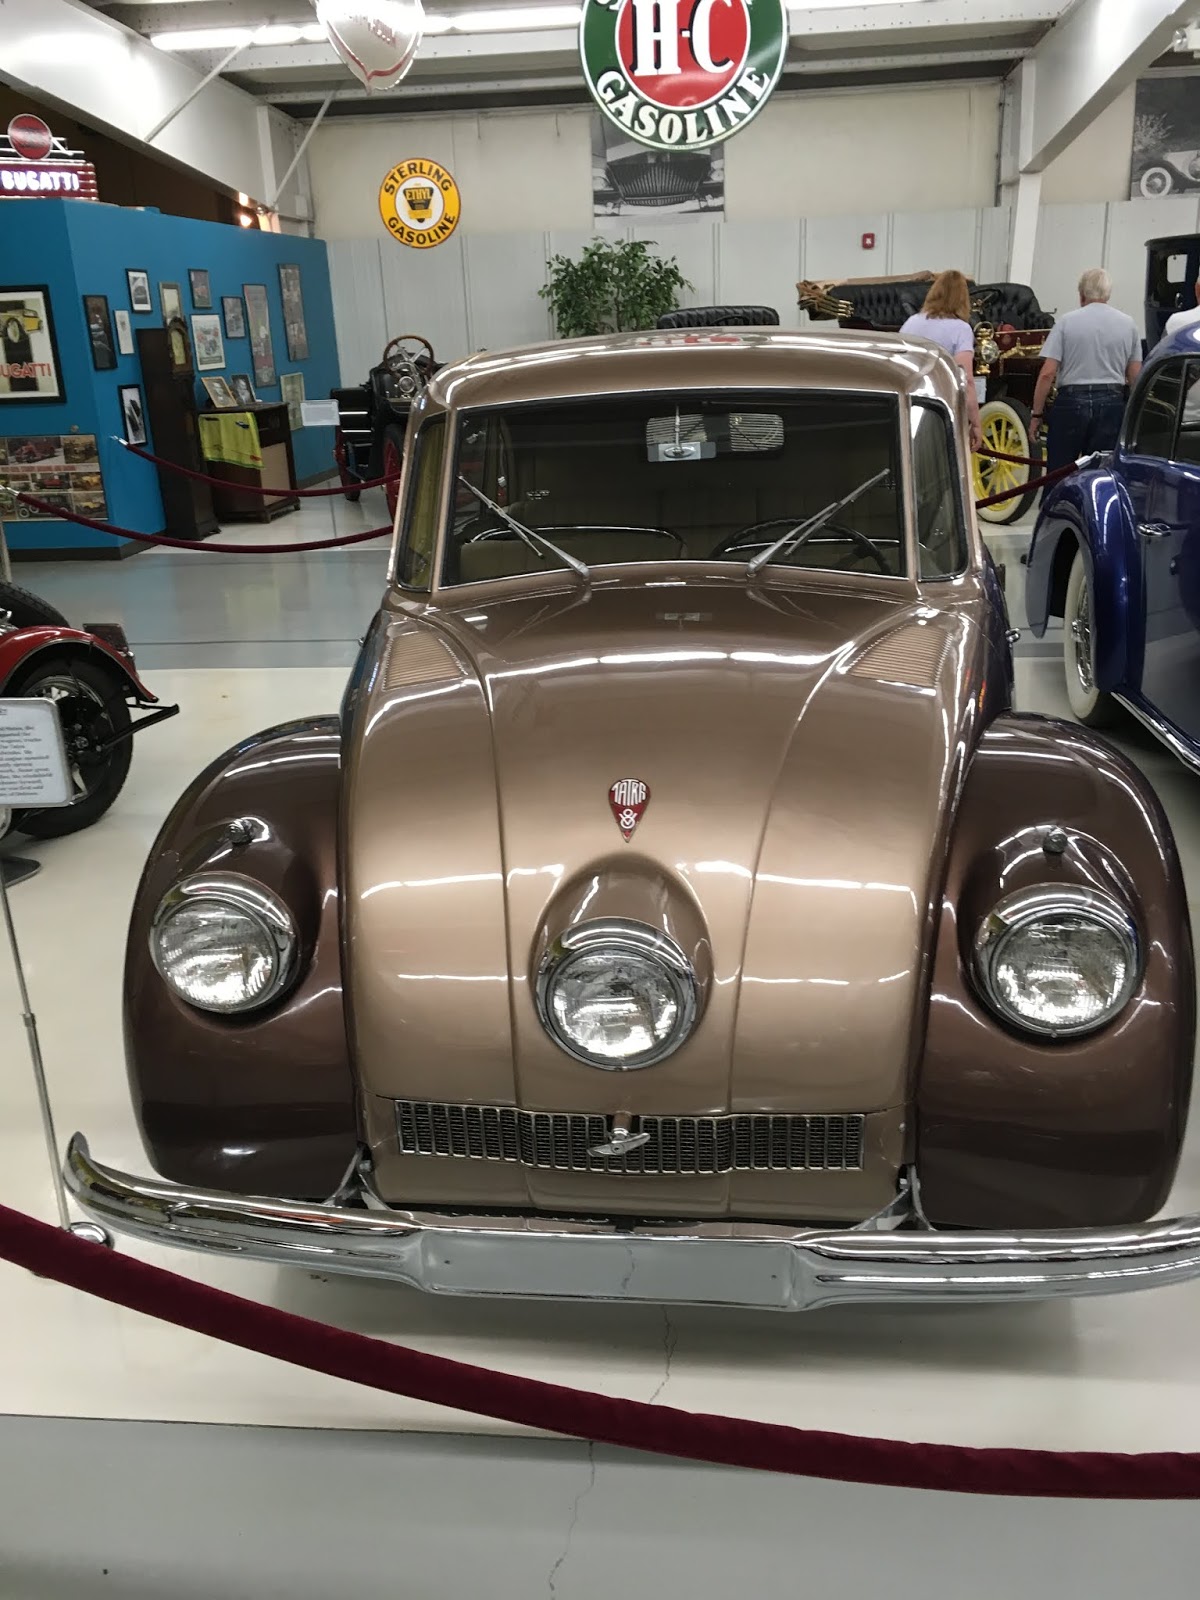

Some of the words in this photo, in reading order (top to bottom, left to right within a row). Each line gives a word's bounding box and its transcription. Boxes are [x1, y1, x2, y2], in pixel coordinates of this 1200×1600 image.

[630, 0, 735, 76] H-C
[596, 66, 771, 144] GASOLINE
[1, 170, 80, 191] BUGATTI
[384, 162, 452, 195] STERLING
[406, 189, 431, 200] ETHYL
[387, 212, 456, 244] GASOLINE
[0, 362, 52, 378] UGATTI
